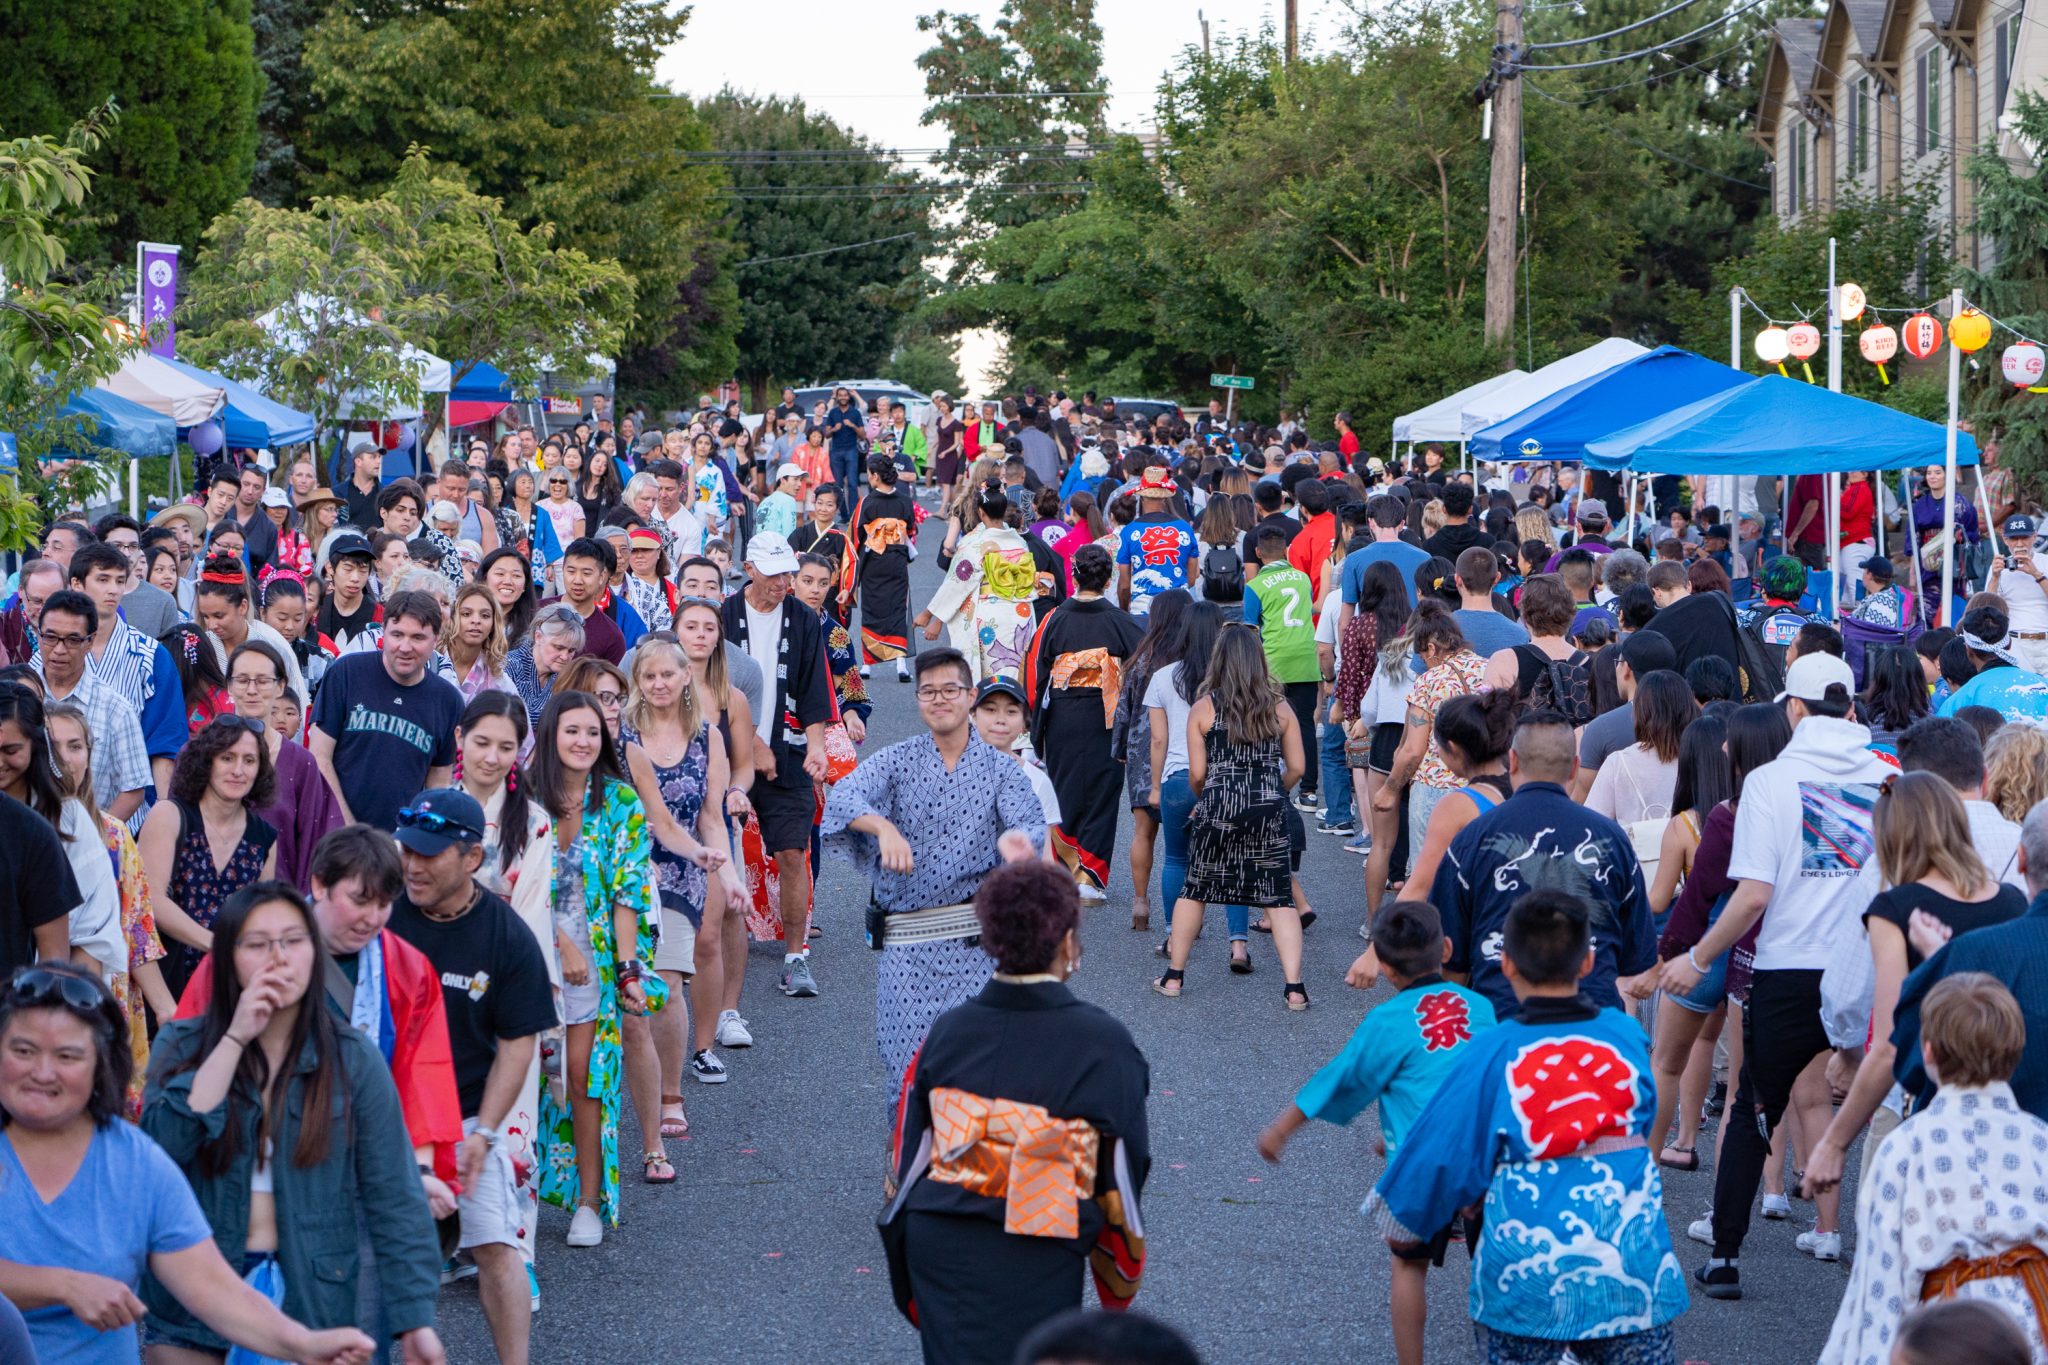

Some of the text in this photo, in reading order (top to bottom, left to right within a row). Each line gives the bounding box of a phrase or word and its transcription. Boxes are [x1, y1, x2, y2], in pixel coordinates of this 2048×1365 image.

[2010, 521, 2026, 530] 水兵
[1139, 525, 1180, 566] 祭
[1262, 570, 1303, 589] DEMPSEY
[1280, 587, 1304, 627] 2
[1778, 625, 1801, 635] CALPIC
[345, 708, 434, 754] MARINERS
[1801, 870, 1826, 878] EYES
[441, 971, 473, 990] ONLY
[1415, 991, 1473, 1053] 祭
